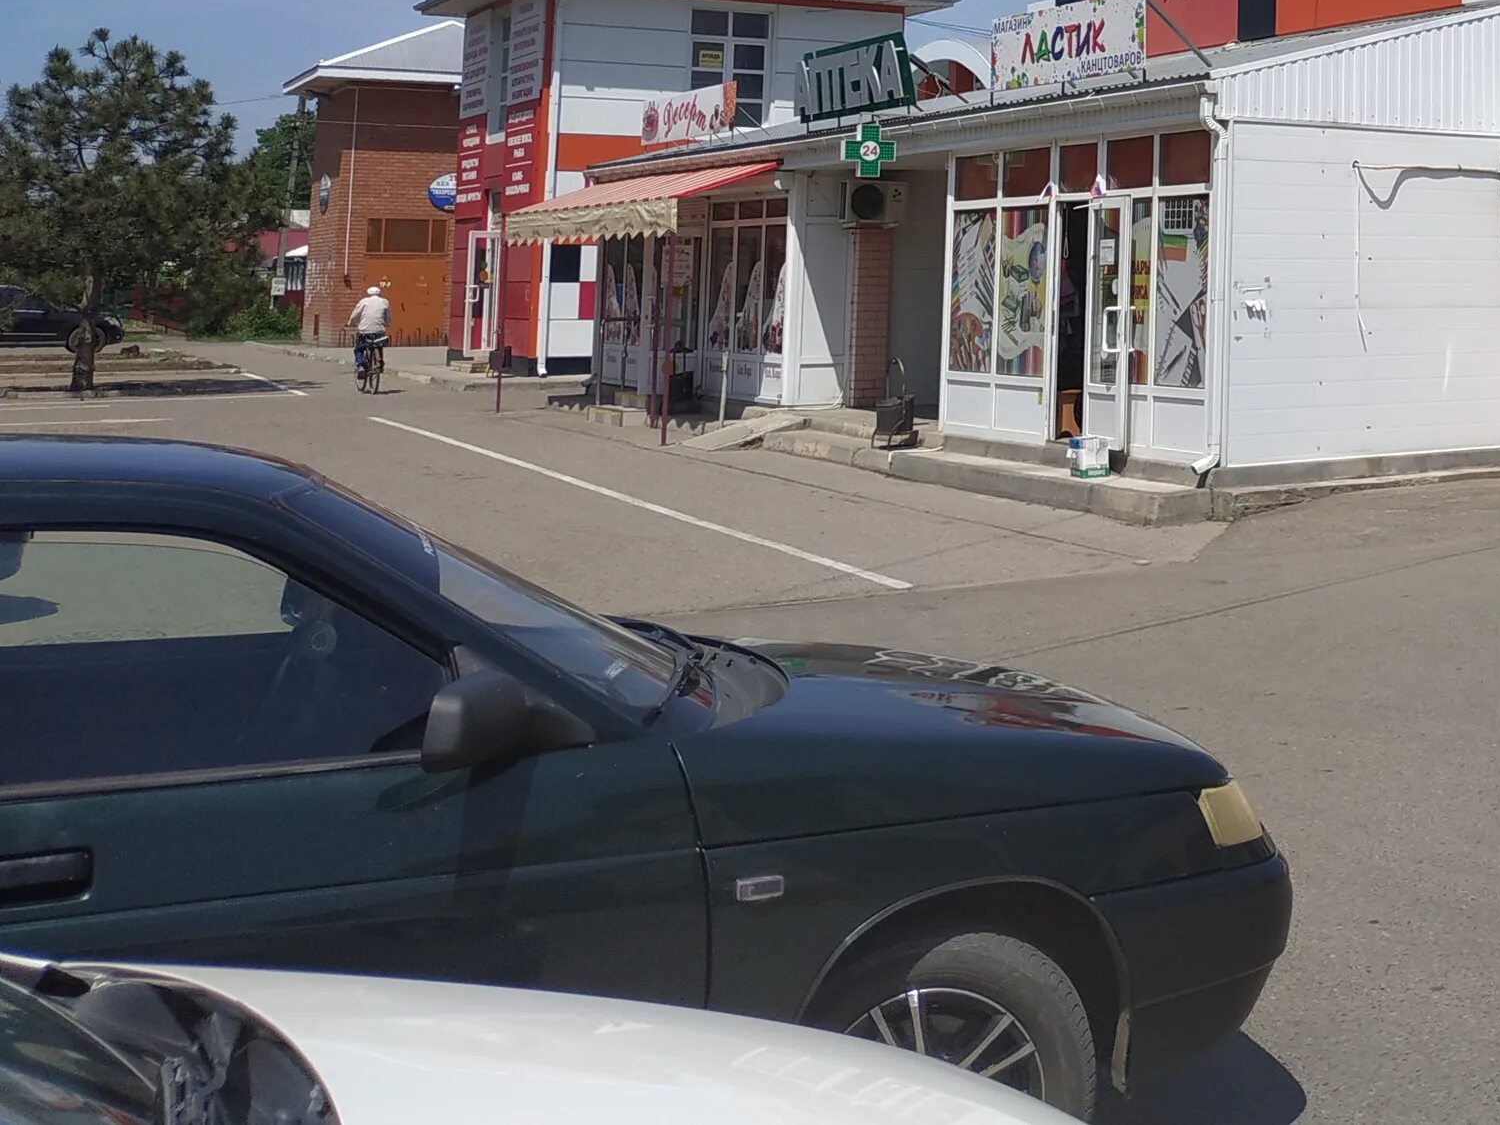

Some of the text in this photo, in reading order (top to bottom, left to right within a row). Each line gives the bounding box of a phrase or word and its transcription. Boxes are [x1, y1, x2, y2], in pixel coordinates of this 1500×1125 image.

[993, 18, 1030, 35] МАГАЗИН
[1021, 17, 1106, 65] ЛАСТИК
[1081, 50, 1142, 72] КАНЦТОВАРОВ
[794, 40, 904, 117] АПТЕКА
[663, 94, 707, 138] Десерт
[862, 145, 878, 156] 24
